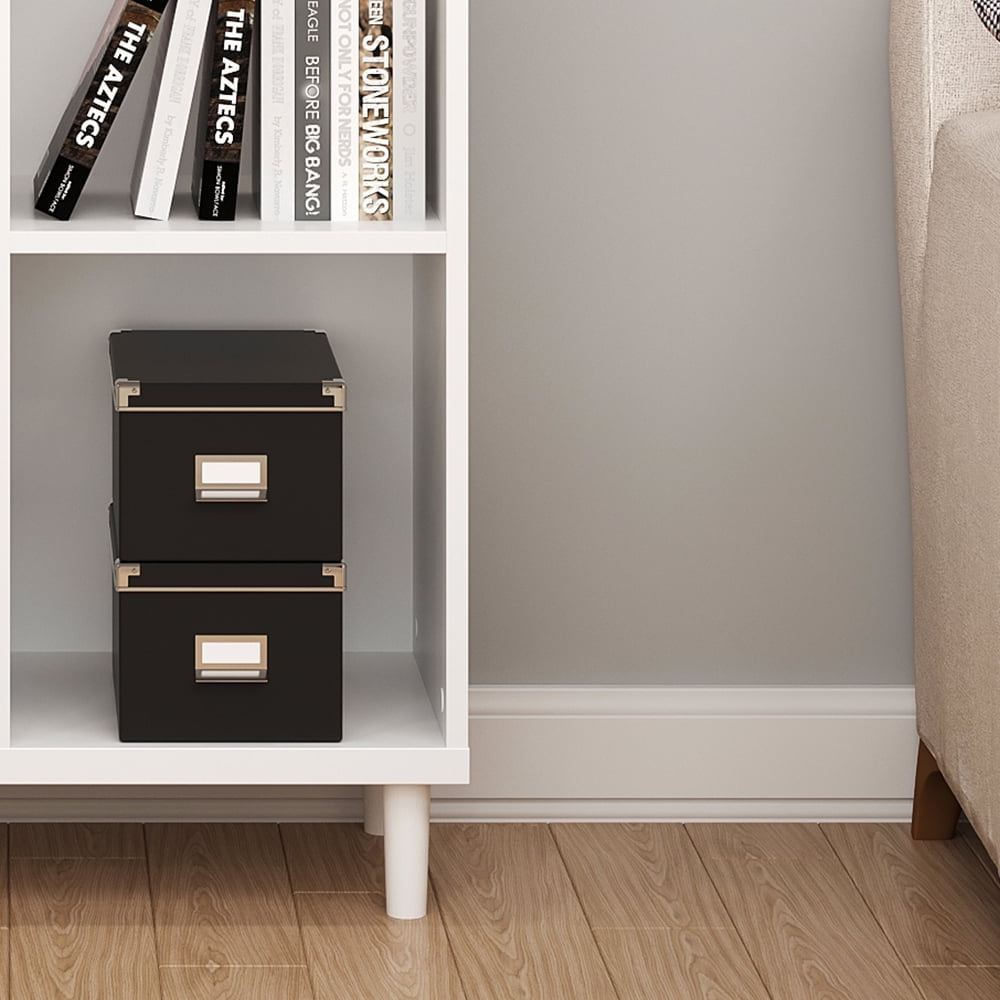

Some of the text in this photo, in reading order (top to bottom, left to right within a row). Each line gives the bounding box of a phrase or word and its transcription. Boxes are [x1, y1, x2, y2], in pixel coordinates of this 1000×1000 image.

[307, 0, 319, 42] EAGLE
[338, 35, 351, 81] ONLY
[75, 21, 147, 149] THE AZTECS
[215, 8, 245, 145] THE AZTECS
[338, 83, 351, 117] FOR
[305, 55, 320, 216] BEFORE BIG BANG!
[338, 119, 351, 167] NERDS
[362, 34, 390, 215] STONEWORKS
